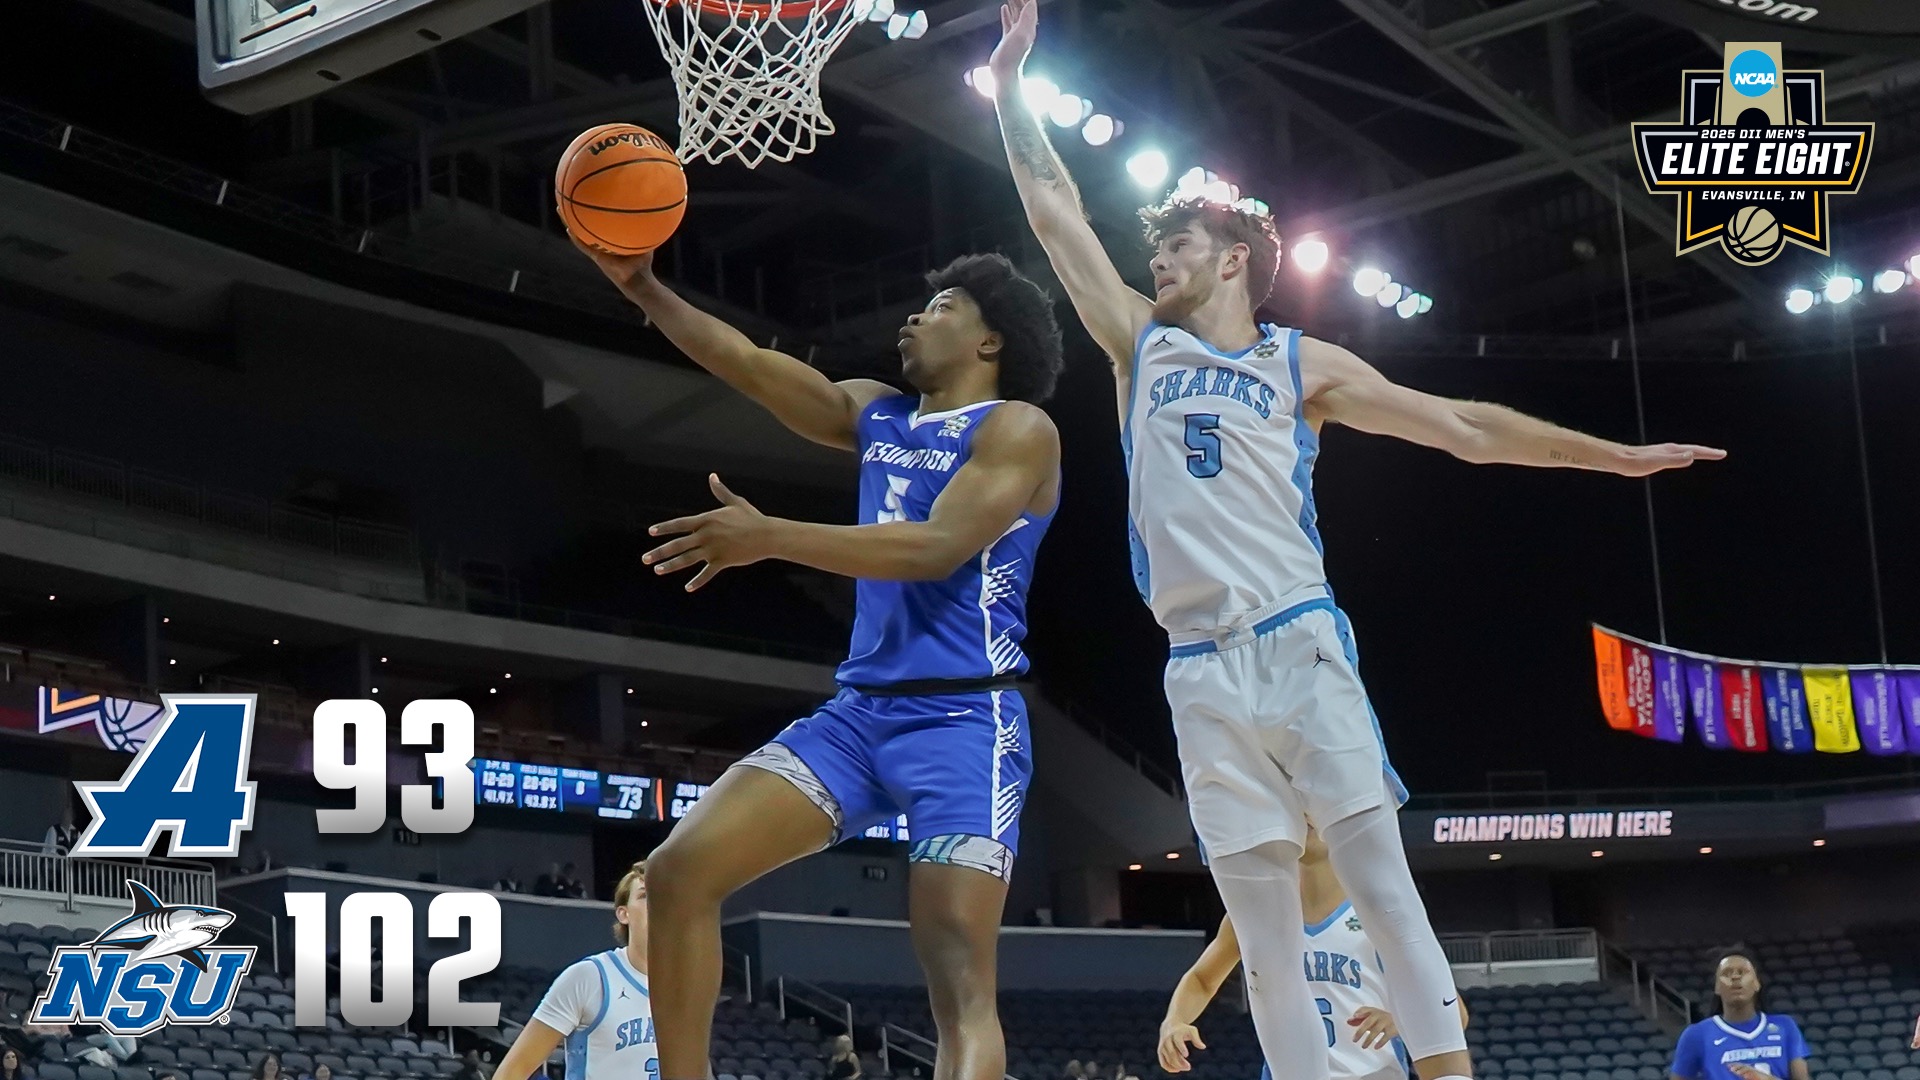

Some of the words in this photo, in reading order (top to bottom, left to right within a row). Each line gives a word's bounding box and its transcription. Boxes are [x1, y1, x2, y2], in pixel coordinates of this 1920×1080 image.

[1718, 0, 1818, 21] om
[1147, 366, 1275, 420] SHARKS
[862, 441, 958, 472] ASSUMPTION
[1184, 413, 1223, 479] 5
[618, 785, 643, 810] 73
[1433, 814, 1565, 843] CHAMPIONS
[1569, 812, 1614, 838] WIN
[1617, 810, 1673, 837] HERE
